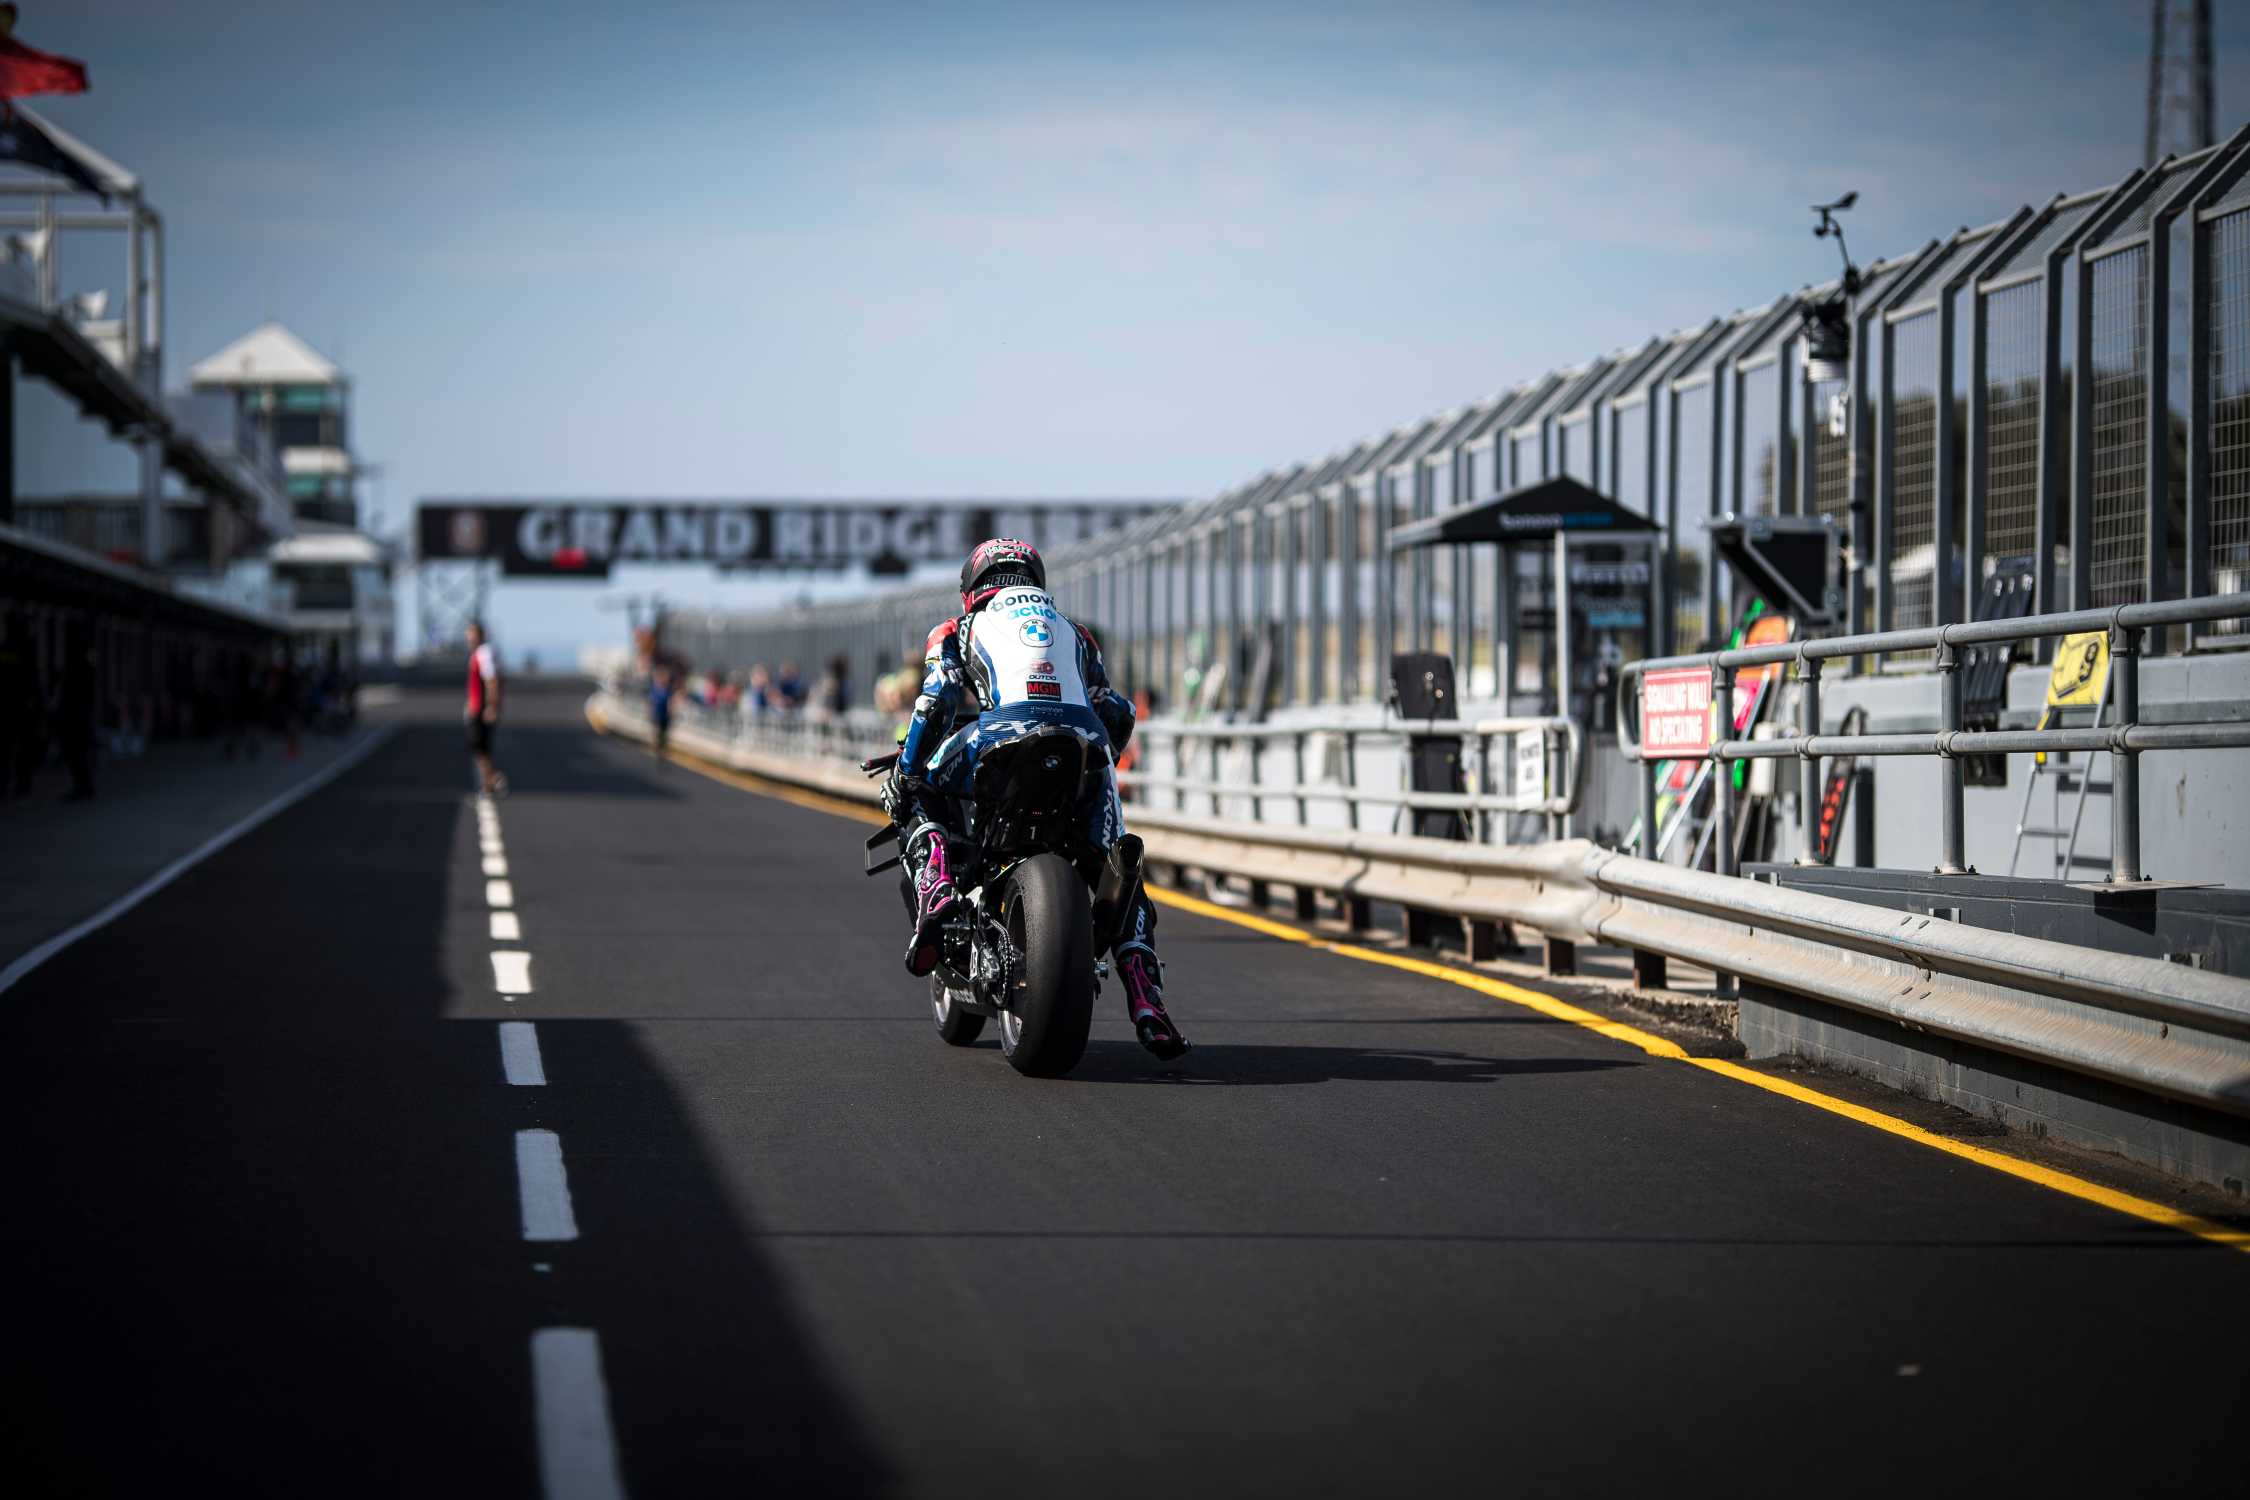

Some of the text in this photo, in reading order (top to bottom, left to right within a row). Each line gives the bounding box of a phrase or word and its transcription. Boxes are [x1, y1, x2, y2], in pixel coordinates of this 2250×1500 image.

[515, 507, 756, 562] GRAND
[774, 507, 963, 560] RIDGE
[984, 573, 1034, 587] REDDING
[1008, 605, 1057, 621] actio
[1027, 682, 1060, 695] MGM
